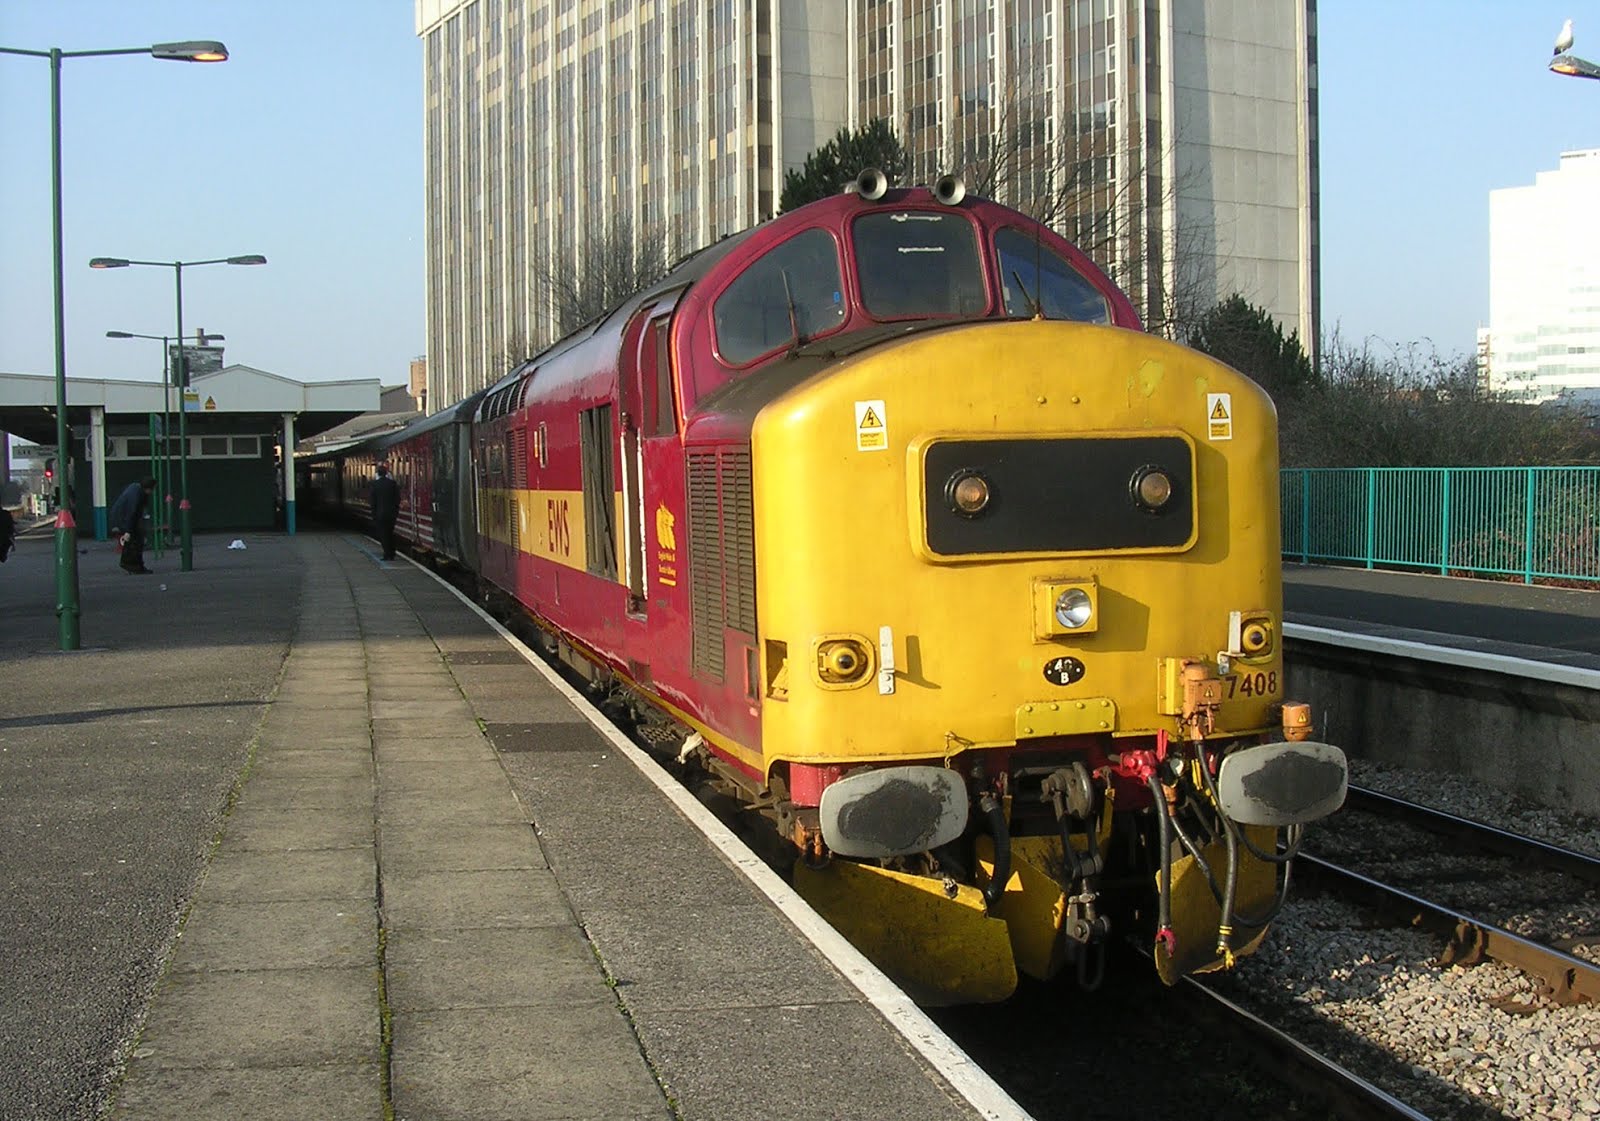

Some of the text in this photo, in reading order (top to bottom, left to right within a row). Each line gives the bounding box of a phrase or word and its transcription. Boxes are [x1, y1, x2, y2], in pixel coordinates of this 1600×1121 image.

[547, 499, 570, 557] EWS
[1060, 672, 1070, 684] B
[1225, 671, 1277, 699] 7408
